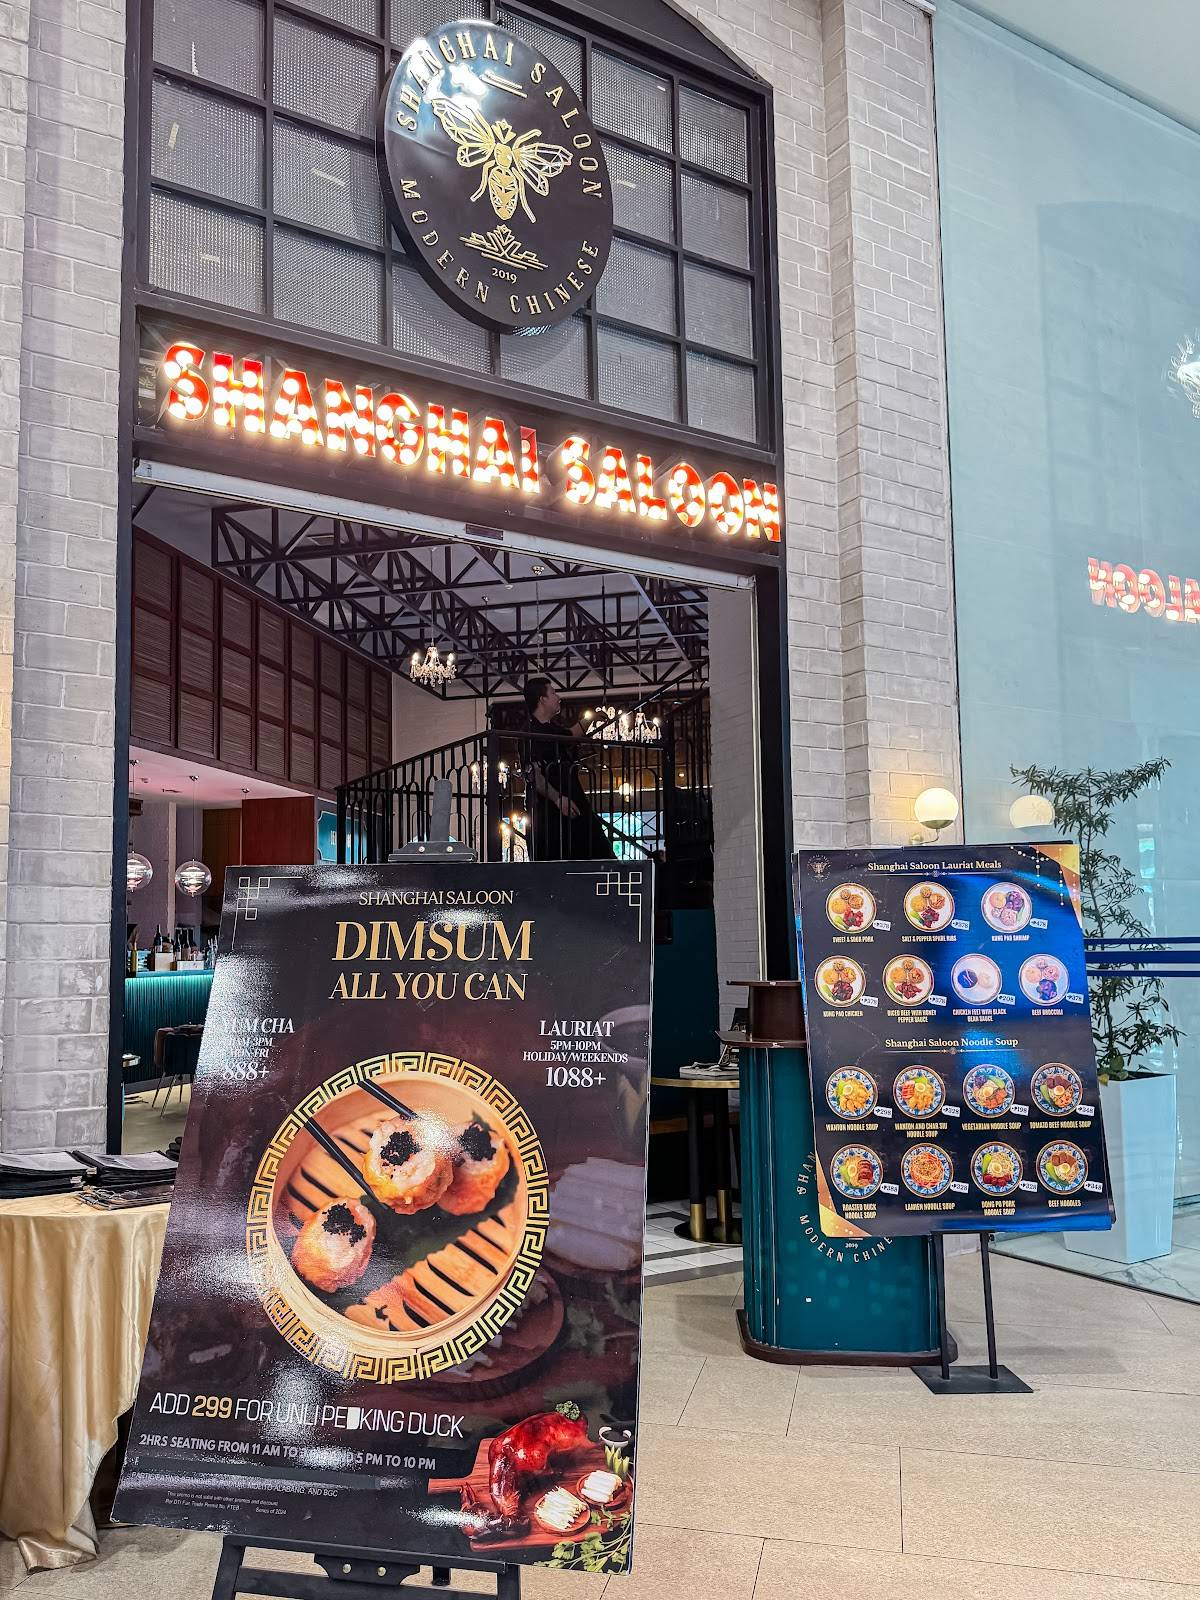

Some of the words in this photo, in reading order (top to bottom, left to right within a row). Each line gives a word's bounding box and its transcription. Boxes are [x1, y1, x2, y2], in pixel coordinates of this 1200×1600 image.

[397, 31, 514, 131] SHANGHAI
[531, 62, 602, 198] SALOON
[400, 178, 490, 303] MODERN
[509, 240, 599, 315] CHINESE
[490, 267, 518, 284] 2019
[164, 342, 541, 494] SHANGHAI
[561, 436, 781, 543] SALOON
[867, 861, 908, 872] Shanghai
[909, 861, 940, 870] Saloon
[941, 860, 974, 870] Lauriat
[975, 860, 1002, 869] Meals
[358, 890, 443, 906] SHANGHAI
[446, 889, 514, 905] SALOON
[331, 919, 536, 962] DIMSUM
[328, 971, 388, 1000] ALL
[392, 971, 459, 1000] YOU
[464, 972, 529, 1001] CAN
[260, 1017, 296, 1034] CHA
[538, 1020, 615, 1037] LAURIAT
[550, 1040, 602, 1051] 5PM-10PM
[885, 1038, 926, 1049] Shanghai
[928, 1038, 959, 1047] Saloon
[961, 1037, 993, 1047] Noodle
[995, 1037, 1019, 1048] Soup
[522, 1051, 629, 1064] HOLIDAY/WEEKENDS
[545, 1066, 607, 1088] 1088+
[846, 1123, 866, 1131] NOODLE
[865, 1123, 879, 1131] SOUP
[962, 1123, 991, 1131] VEGETARIAN
[990, 1122, 1009, 1130] NOODLE
[1008, 1122, 1022, 1130] SOUP
[1048, 1121, 1060, 1129] BEEF
[1060, 1121, 1079, 1129] NOODLE
[1078, 1120, 1092, 1128] SOUP
[906, 1130, 925, 1138] NOODLE
[925, 1130, 938, 1138] SOUP
[796, 1151, 817, 1195] SHAN
[863, 1203, 877, 1211] DUCK
[924, 1203, 942, 1211] NOODLE
[942, 1202, 956, 1210] SOUP
[1047, 1200, 1059, 1208] BEEF
[1059, 1199, 1082, 1207] NOODLES
[844, 1211, 864, 1220] NOODLE
[863, 1211, 877, 1219] SOUP
[983, 1208, 1002, 1216] NOODLE
[1002, 1208, 1016, 1216] SOUP
[799, 1214, 844, 1262] MODERN
[853, 1236, 893, 1263] CHINE
[149, 1392, 191, 1415] ADD
[191, 1395, 233, 1419] 299
[234, 1398, 274, 1422] FOR
[276, 1401, 320, 1427] UNLI
[407, 1411, 465, 1438] DUCK
[138, 1433, 168, 1447] 2HRS
[169, 1435, 216, 1451] SEATING
[217, 1440, 249, 1454] FROM
[251, 1443, 261, 1455] 11
[261, 1444, 281, 1457] AM
[283, 1445, 298, 1458] TO
[355, 1452, 364, 1464] 5
[365, 1452, 383, 1465] PM
[385, 1455, 401, 1467] TO
[403, 1456, 416, 1469] 10
[418, 1458, 436, 1470] PM
[307, 1487, 323, 1496] AND
[323, 1489, 339, 1497] BGC
